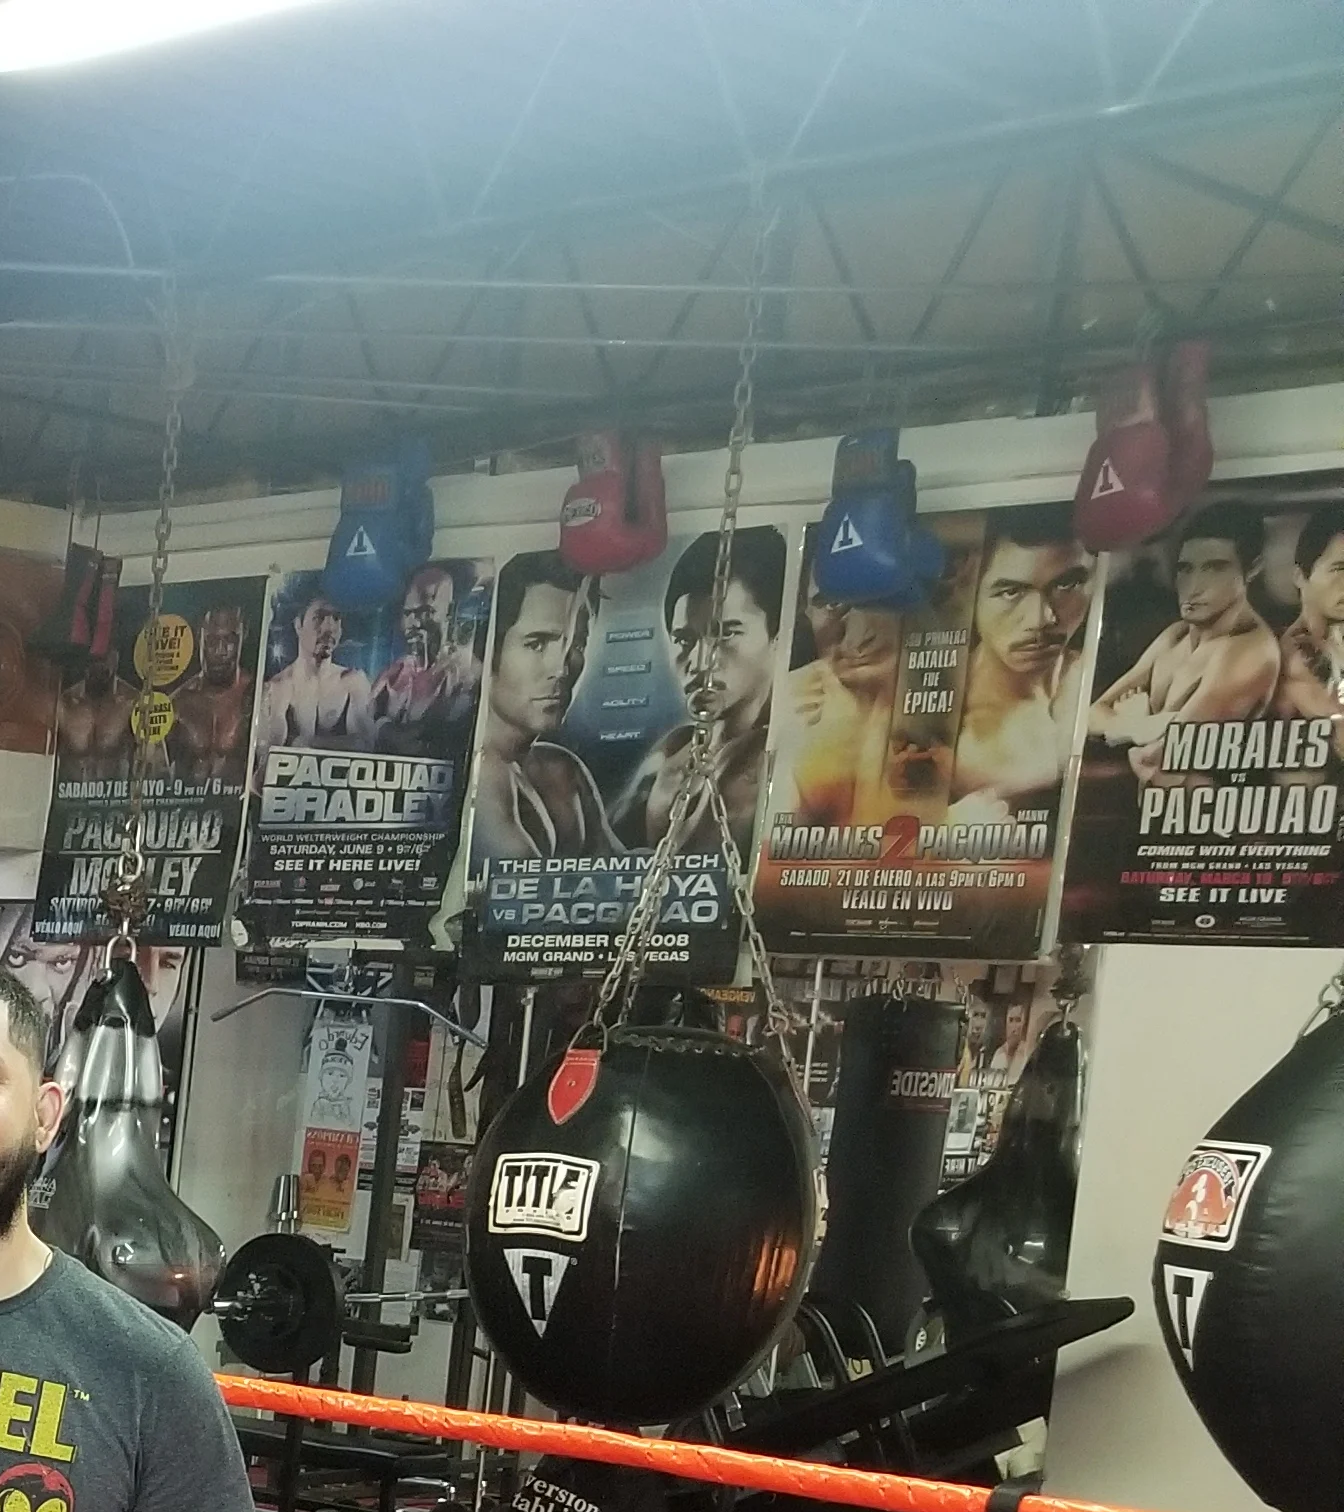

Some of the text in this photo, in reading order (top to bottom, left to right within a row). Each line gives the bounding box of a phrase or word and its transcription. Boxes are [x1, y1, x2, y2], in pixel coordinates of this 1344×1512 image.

[908, 649, 957, 669] BATALLA
[1162, 718, 1333, 771] MORALES
[264, 753, 454, 792] PACQUIAO
[261, 786, 450, 823] BRADLEY
[1139, 785, 1338, 839] PACQUIAO
[261, 833, 294, 843] WORLD
[296, 832, 368, 843] WELTERWEIGHT
[769, 823, 1049, 865] MORALES PACQUIAO
[269, 844, 384, 858] SATURDAY, JUNE 9
[1137, 844, 1332, 857] COMING WITH EVERYTHING
[273, 859, 421, 872] SEE IT HERE LIVE!
[498, 857, 631, 873] THE DREAM
[490, 876, 597, 900] DE LA
[780, 869, 832, 889] SABADO,
[837, 870, 852, 887] 21
[854, 870, 870, 887] DE
[873, 869, 912, 887] ENERO
[925, 873, 946, 888] LAS
[841, 890, 953, 911] VEALO EN VIVO
[1159, 887, 1288, 904] SEE IT LIVE
[492, 908, 516, 921] VS
[506, 934, 609, 948] DECEMBER
[503, 951, 594, 962] MGM GRAND
